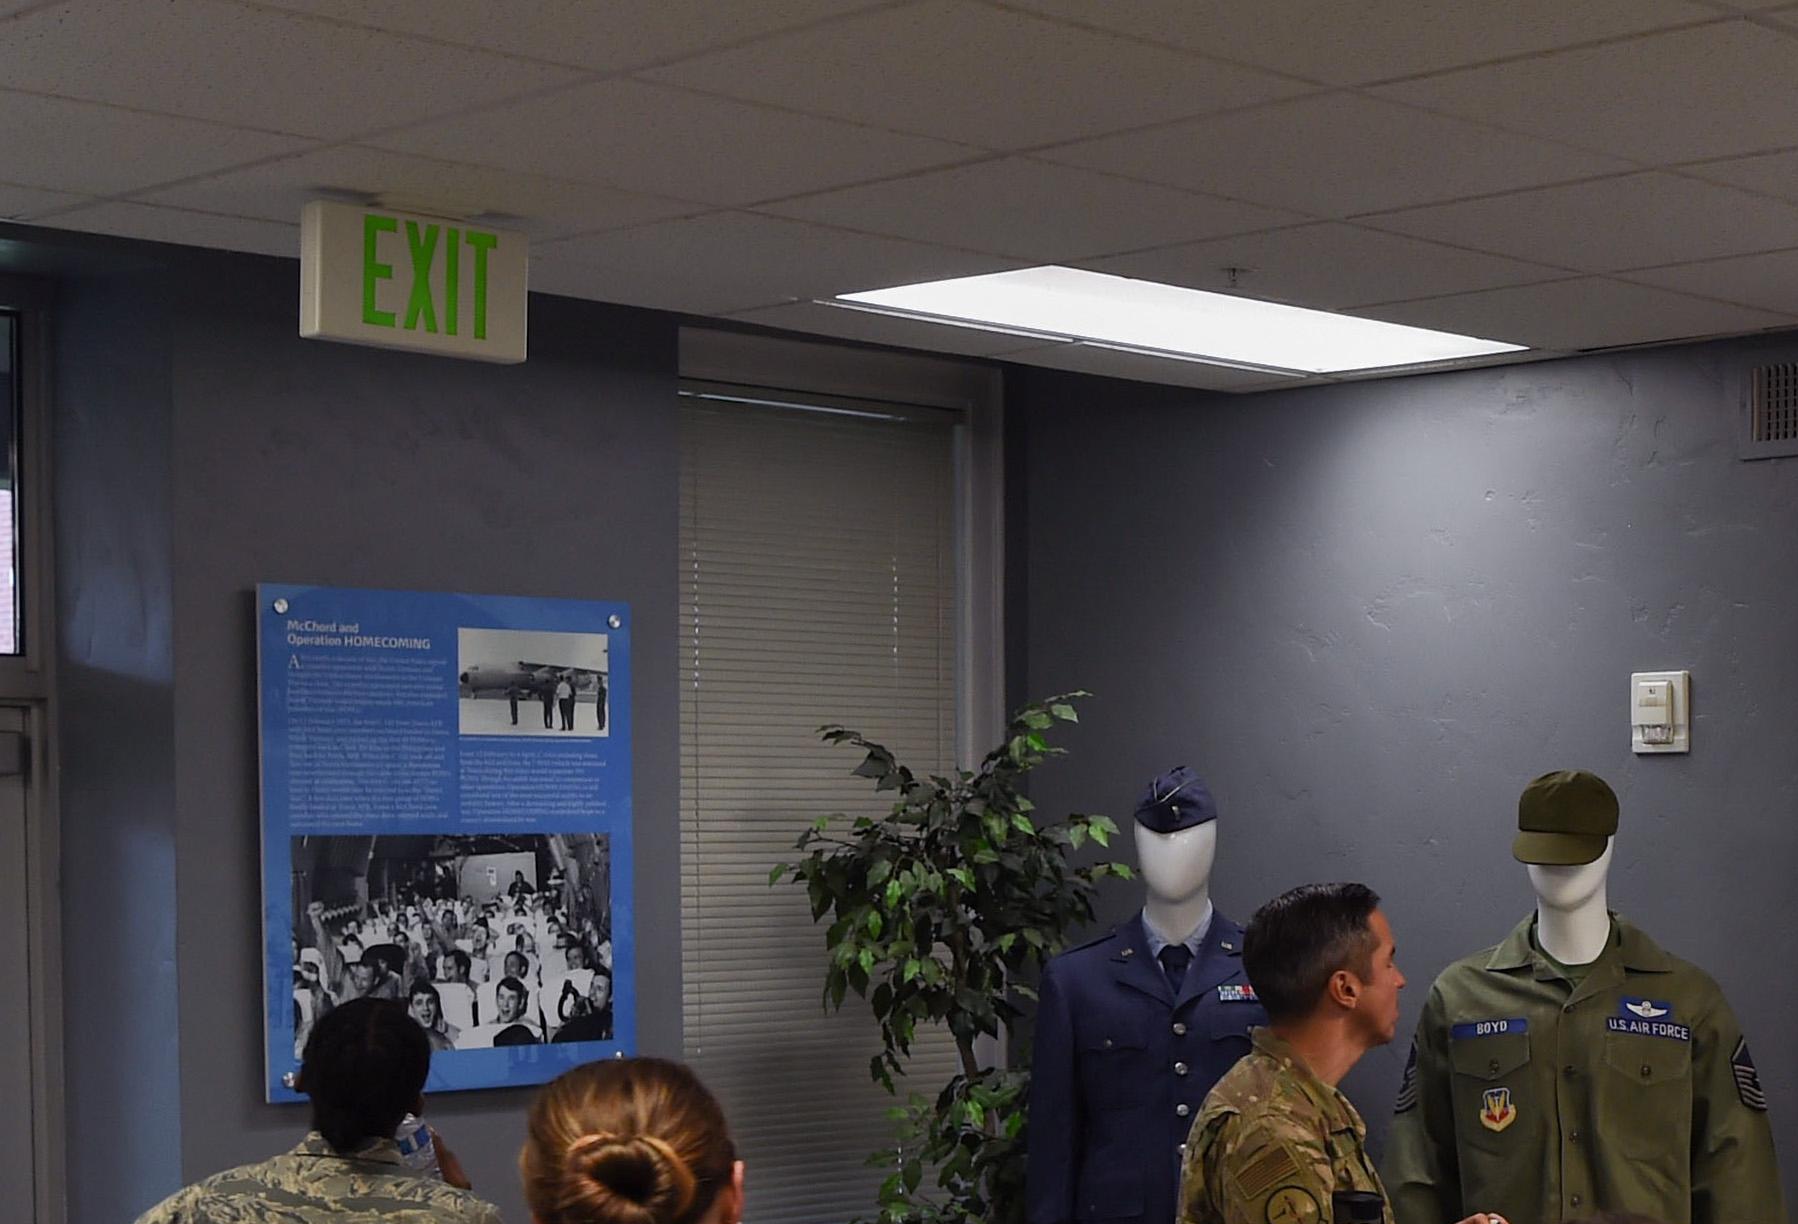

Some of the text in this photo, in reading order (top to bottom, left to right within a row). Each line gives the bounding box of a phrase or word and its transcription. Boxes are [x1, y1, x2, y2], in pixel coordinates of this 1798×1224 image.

[363, 214, 498, 340] EXIT
[287, 620, 359, 633] McChord and
[287, 634, 431, 650] Operation HOMECOMING
[1476, 1021, 1507, 1035] BOYD
[1630, 1021, 1650, 1034] AIR
[1652, 1023, 1688, 1040] FORCE
